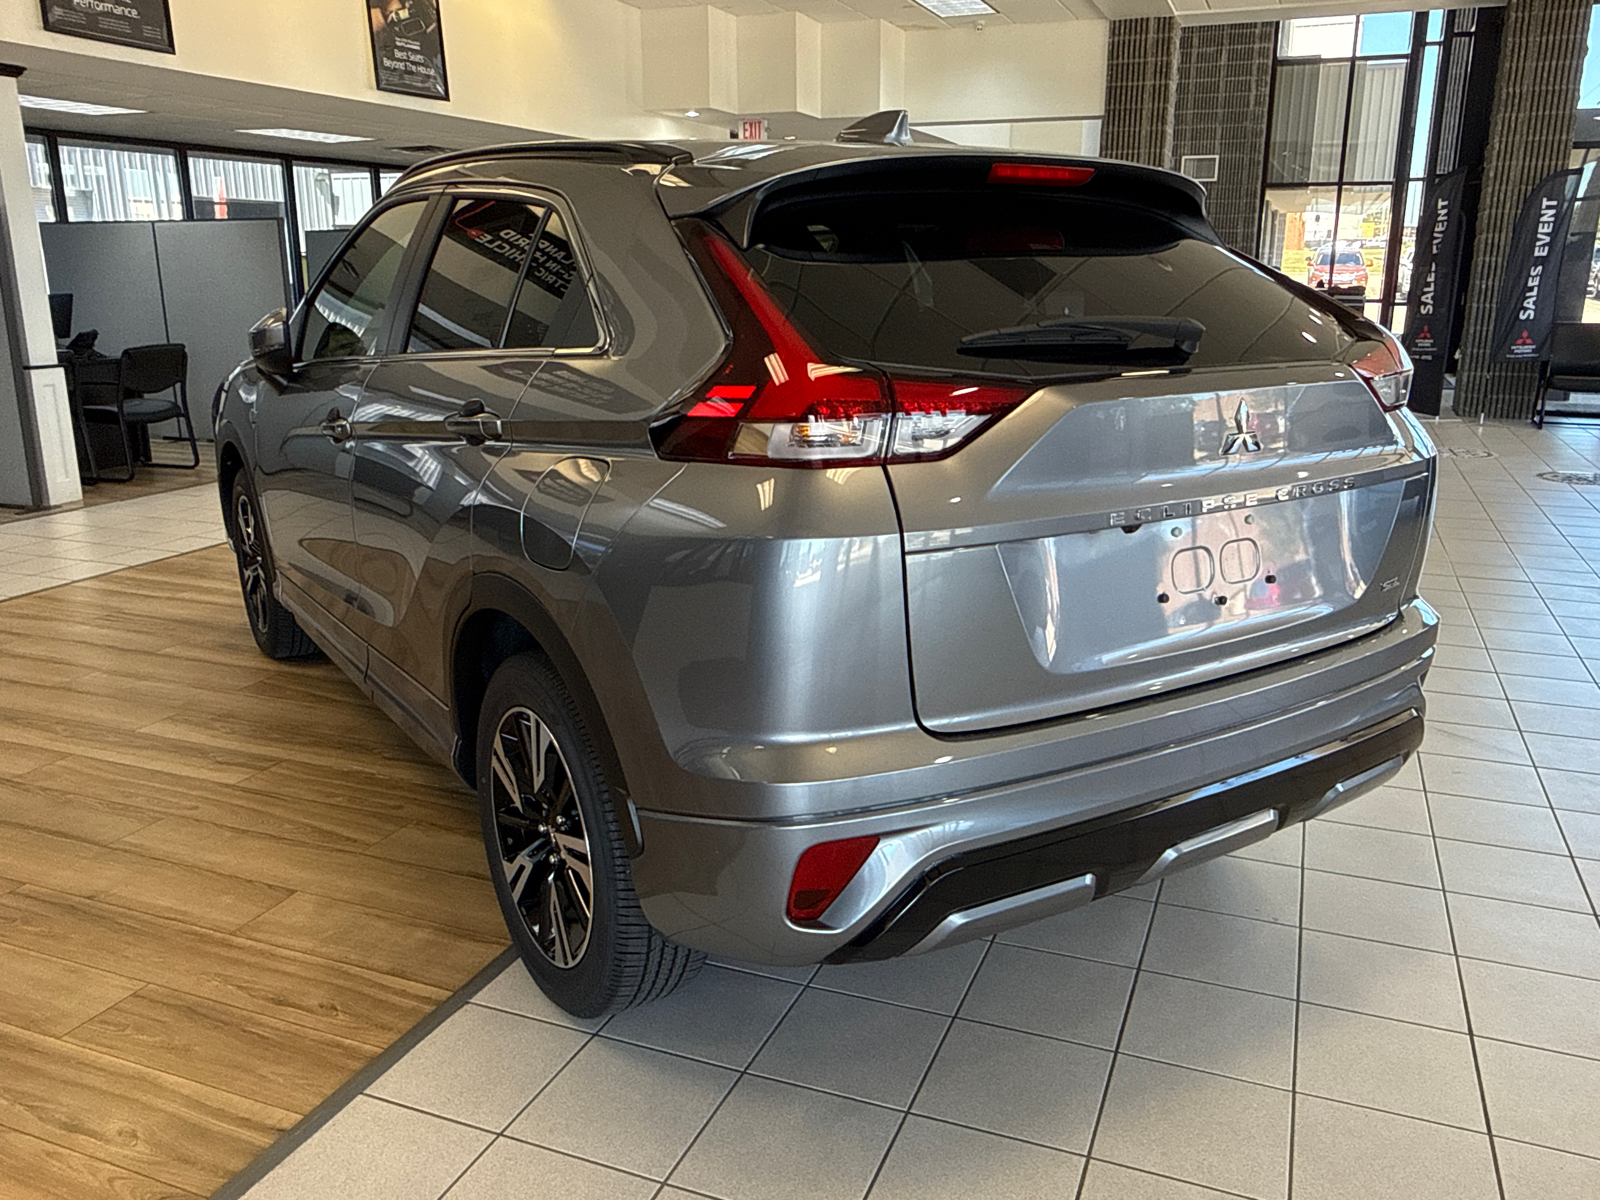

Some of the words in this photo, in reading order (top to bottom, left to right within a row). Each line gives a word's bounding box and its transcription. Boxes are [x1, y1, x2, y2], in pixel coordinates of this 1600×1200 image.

[383, 57, 405, 70] Beyond
[406, 62, 417, 73] The
[394, 48, 408, 60] Best
[408, 51, 425, 63] Seats
[743, 120, 762, 140] EXIT
[1519, 265, 1543, 320] SALES
[1533, 197, 1558, 257] EVENT
[1110, 494, 1258, 526] ECLIPSE
[1275, 477, 1355, 501] CROSS
